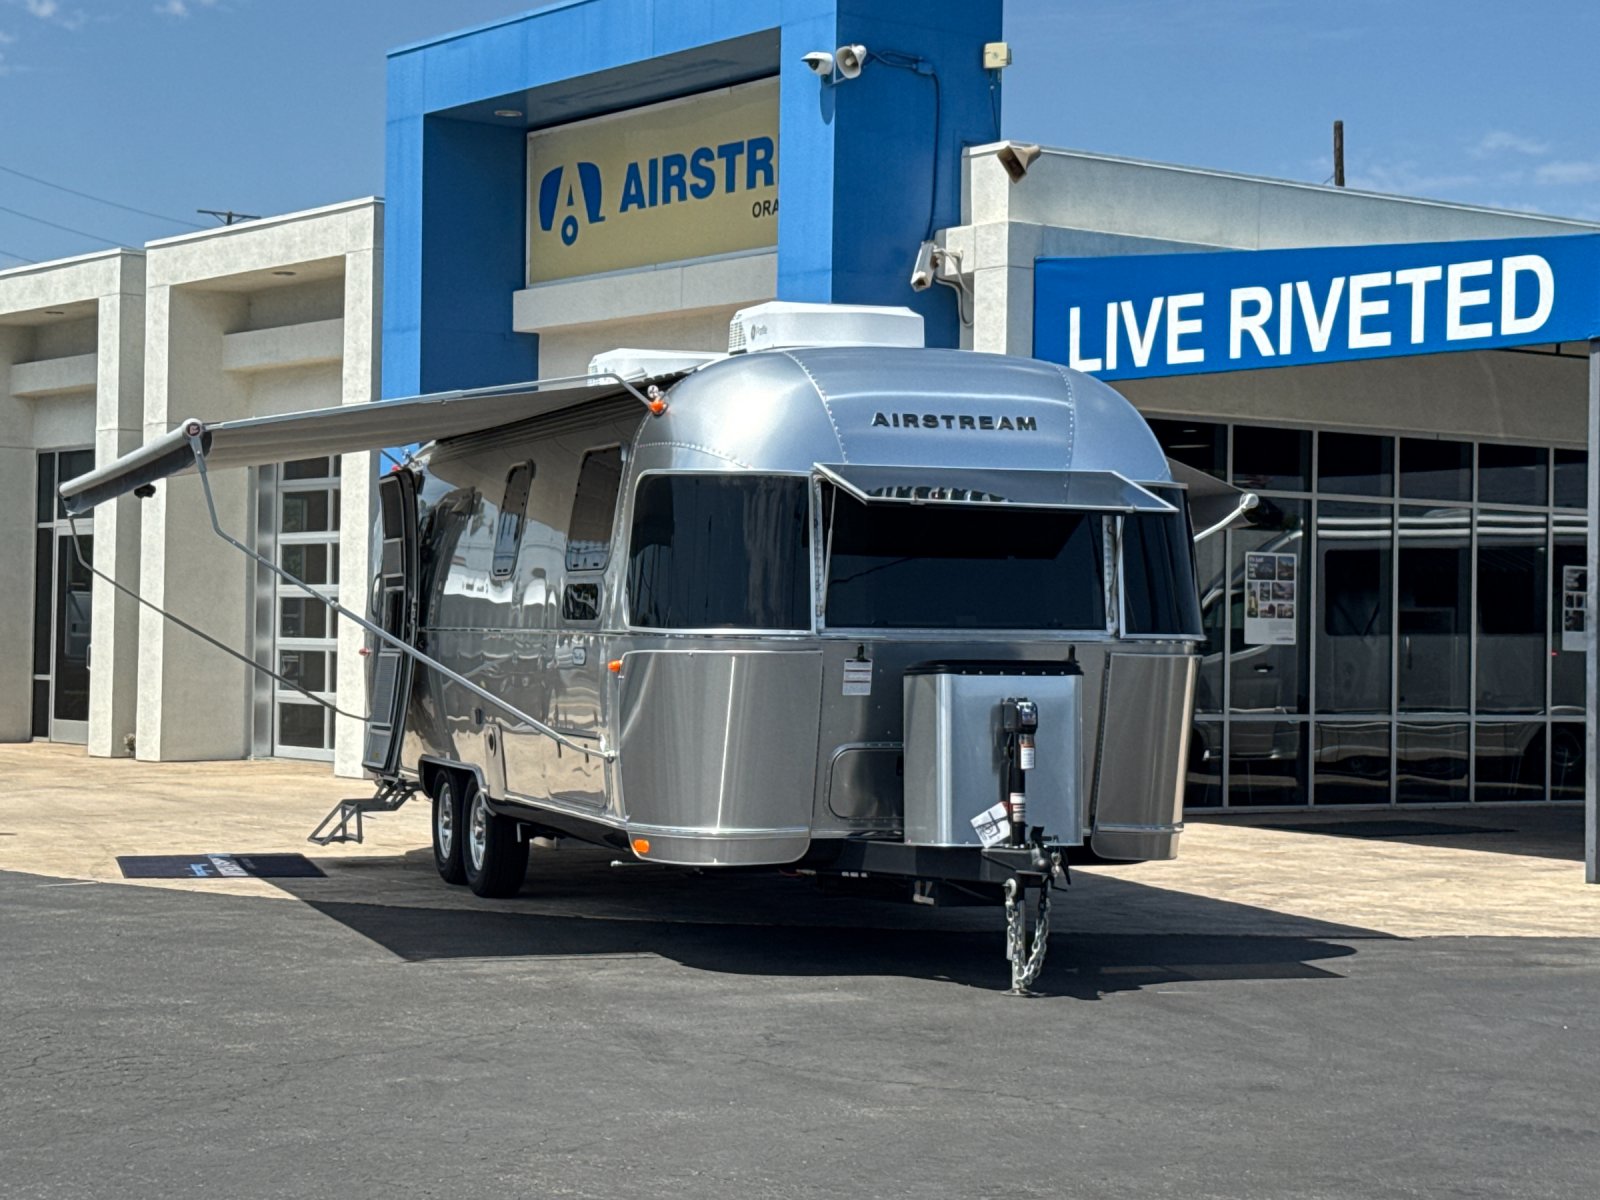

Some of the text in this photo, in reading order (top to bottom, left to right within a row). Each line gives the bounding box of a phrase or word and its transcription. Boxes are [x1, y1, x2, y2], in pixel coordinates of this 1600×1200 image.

[619, 136, 779, 213] AIRSTR
[752, 198, 779, 218] ORA
[1069, 254, 1555, 373] LIVE RIVETED
[871, 412, 1038, 431] AIRSTREAM
